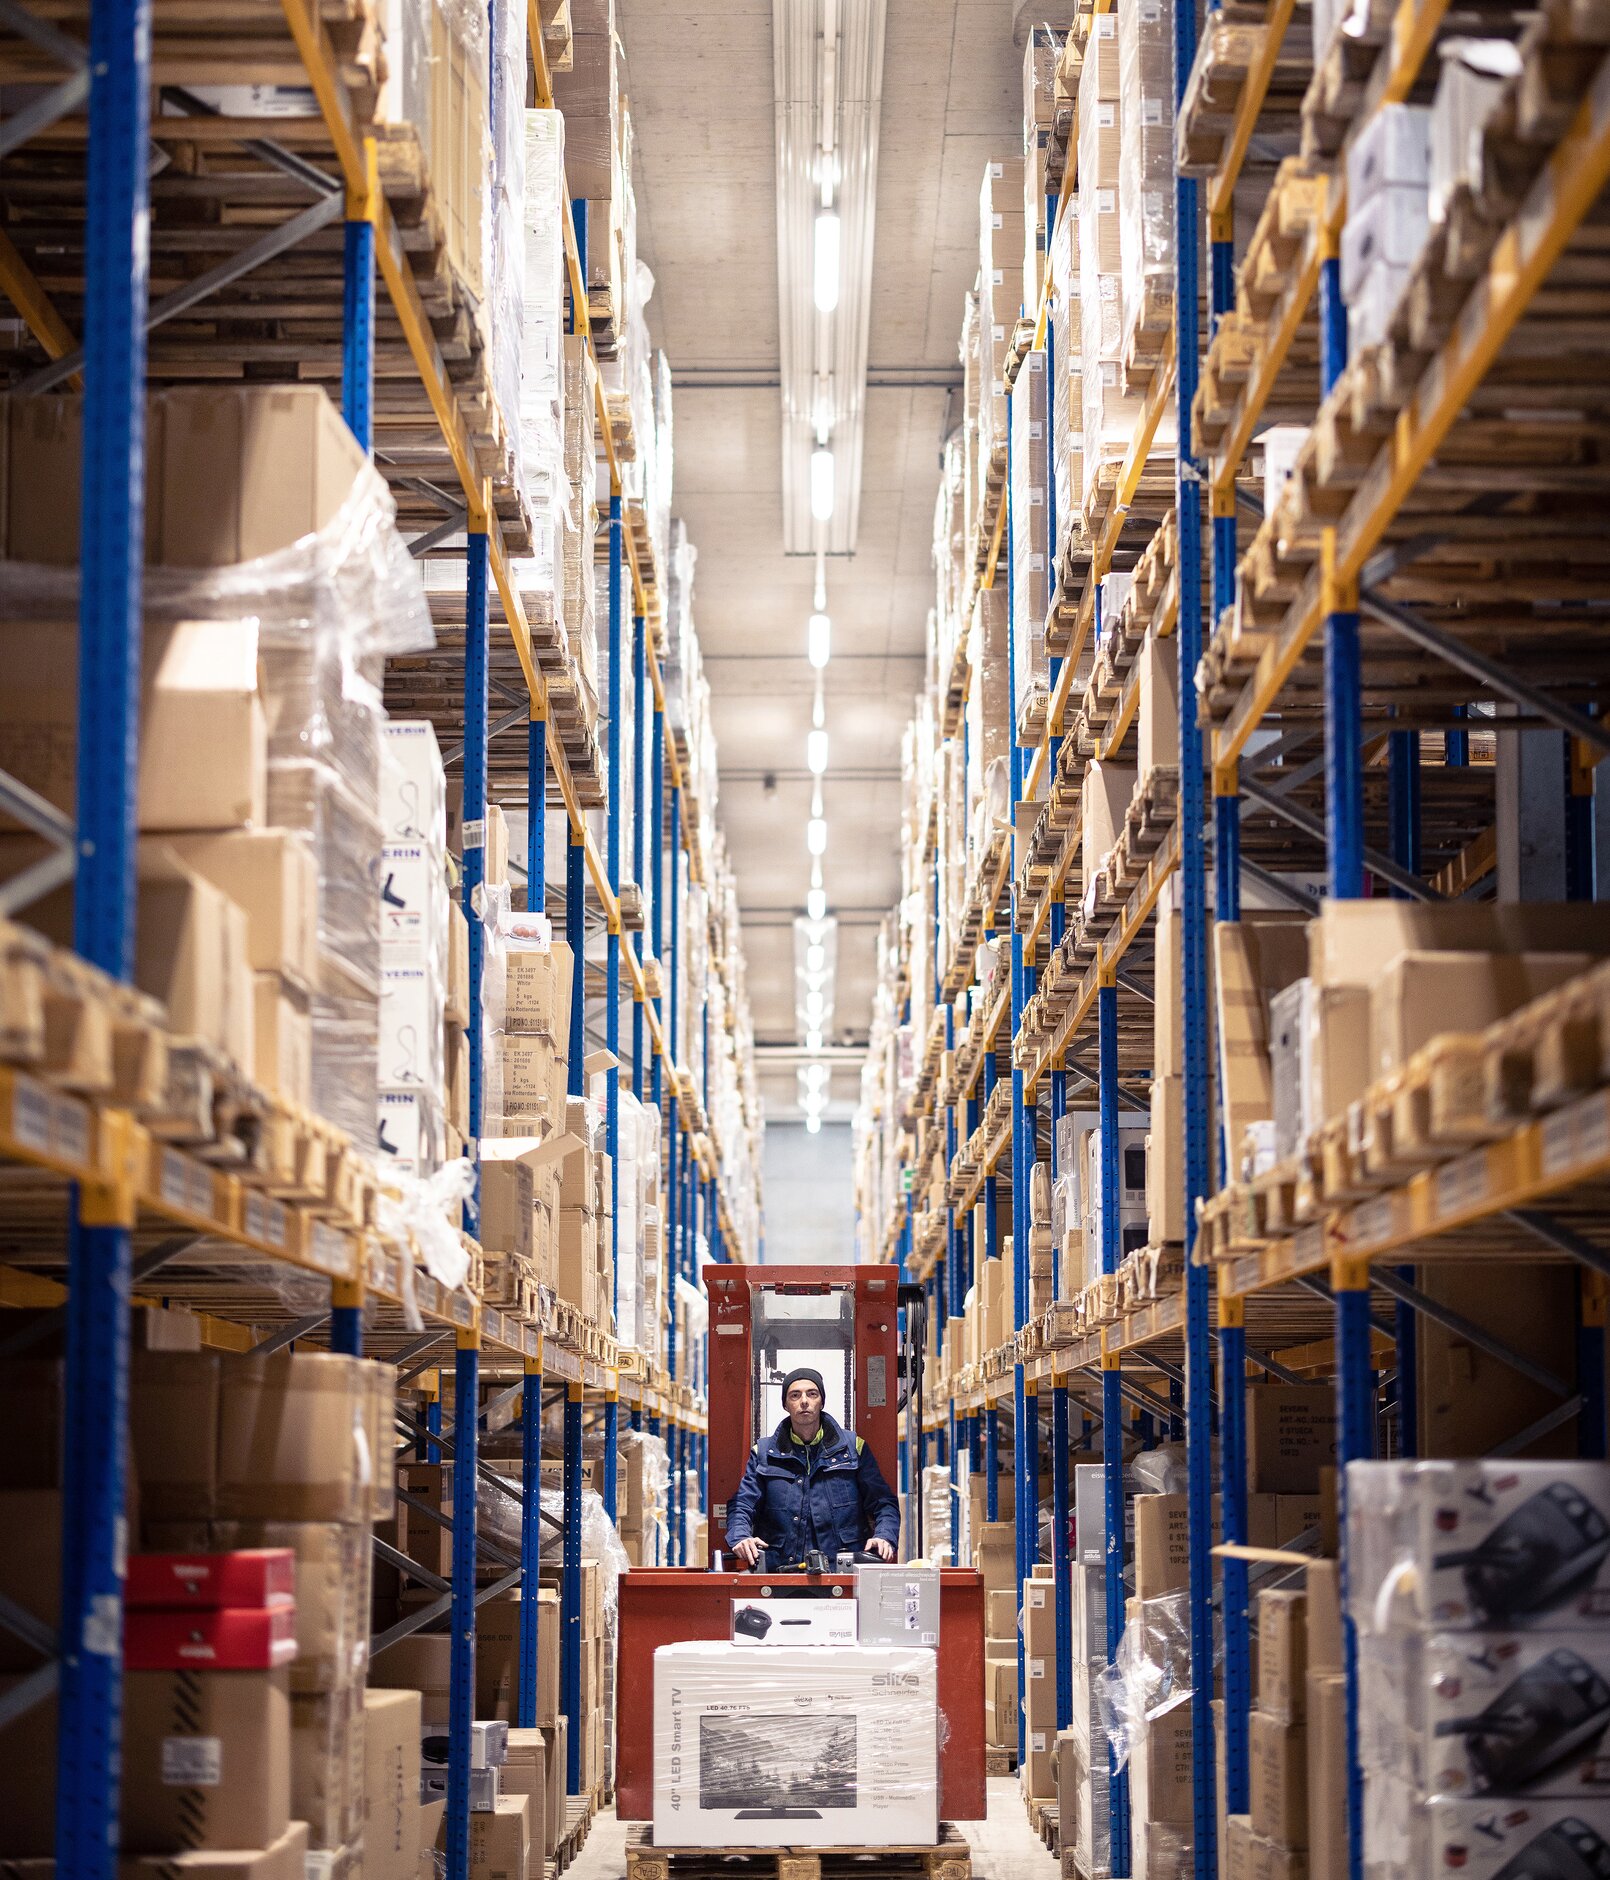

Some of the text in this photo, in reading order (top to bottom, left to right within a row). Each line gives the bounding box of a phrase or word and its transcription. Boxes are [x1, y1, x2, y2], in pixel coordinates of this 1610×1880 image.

[871, 1672, 920, 1686] silva
[671, 1687, 682, 1707] TV
[871, 1688, 920, 1697] Schneider
[671, 1710, 682, 1753] Smart
[670, 1756, 682, 1784] LED
